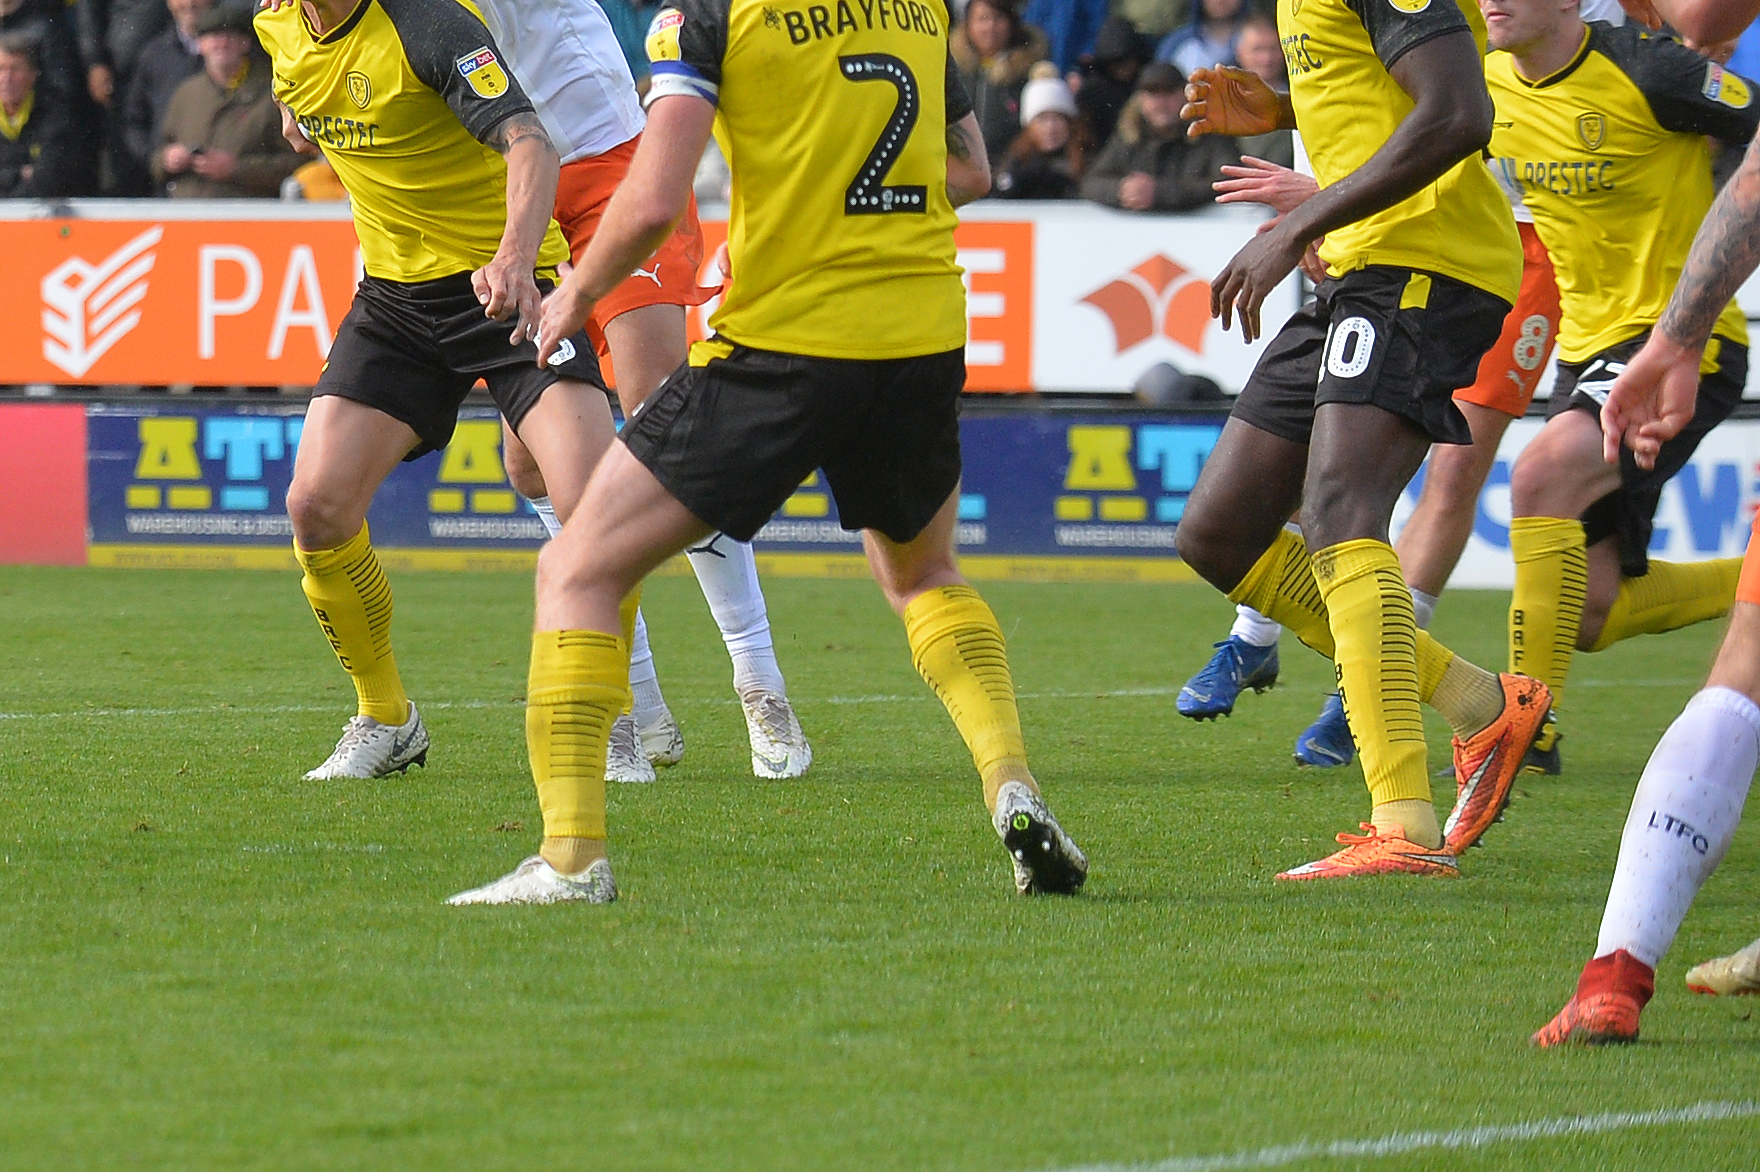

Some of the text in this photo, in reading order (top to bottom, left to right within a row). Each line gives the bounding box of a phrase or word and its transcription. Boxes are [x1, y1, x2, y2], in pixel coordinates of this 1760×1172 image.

[461, 59, 478, 74] sky
[837, 52, 928, 217] 2
[1513, 314, 1550, 371] 8
[1513, 609, 1525, 675] BAF
